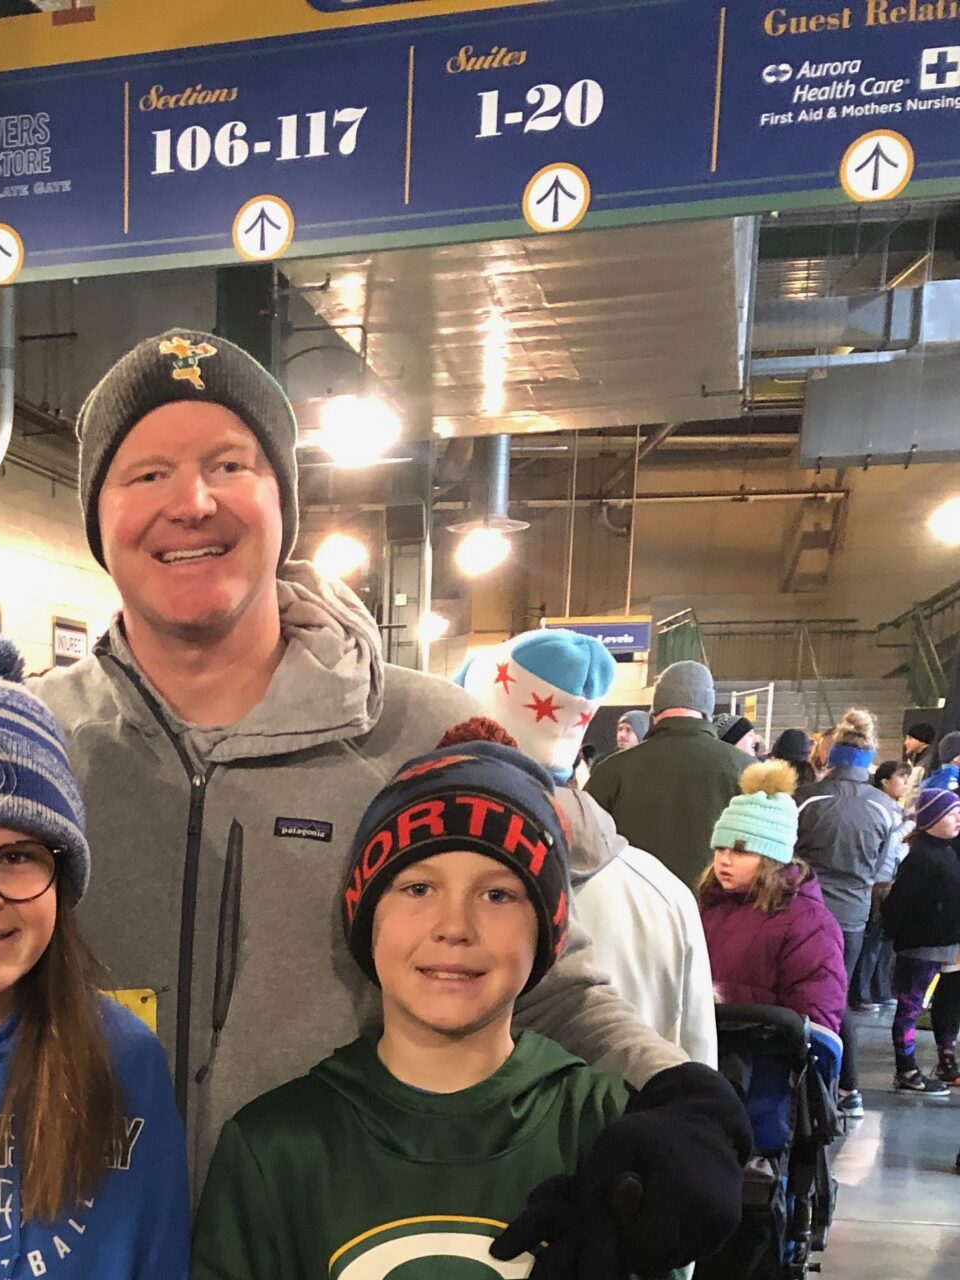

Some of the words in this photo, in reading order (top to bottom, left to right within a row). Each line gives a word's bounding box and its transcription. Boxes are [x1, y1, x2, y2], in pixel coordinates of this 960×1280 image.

[763, 7, 852, 37] Guest
[446, 45, 528, 74] Suites
[796, 59, 862, 80] Aurora
[139, 83, 238, 111] Sections
[792, 79, 855, 103] Health
[475, 79, 604, 138] 1-20
[760, 113, 793, 126] First
[798, 108, 823, 122] Aid
[827, 106, 837, 119] &
[842, 102, 902, 118] Mothers
[150, 106, 368, 176] 106-117
[281, 827, 325, 838] patagonia
[345, 797, 548, 919] NORTH
